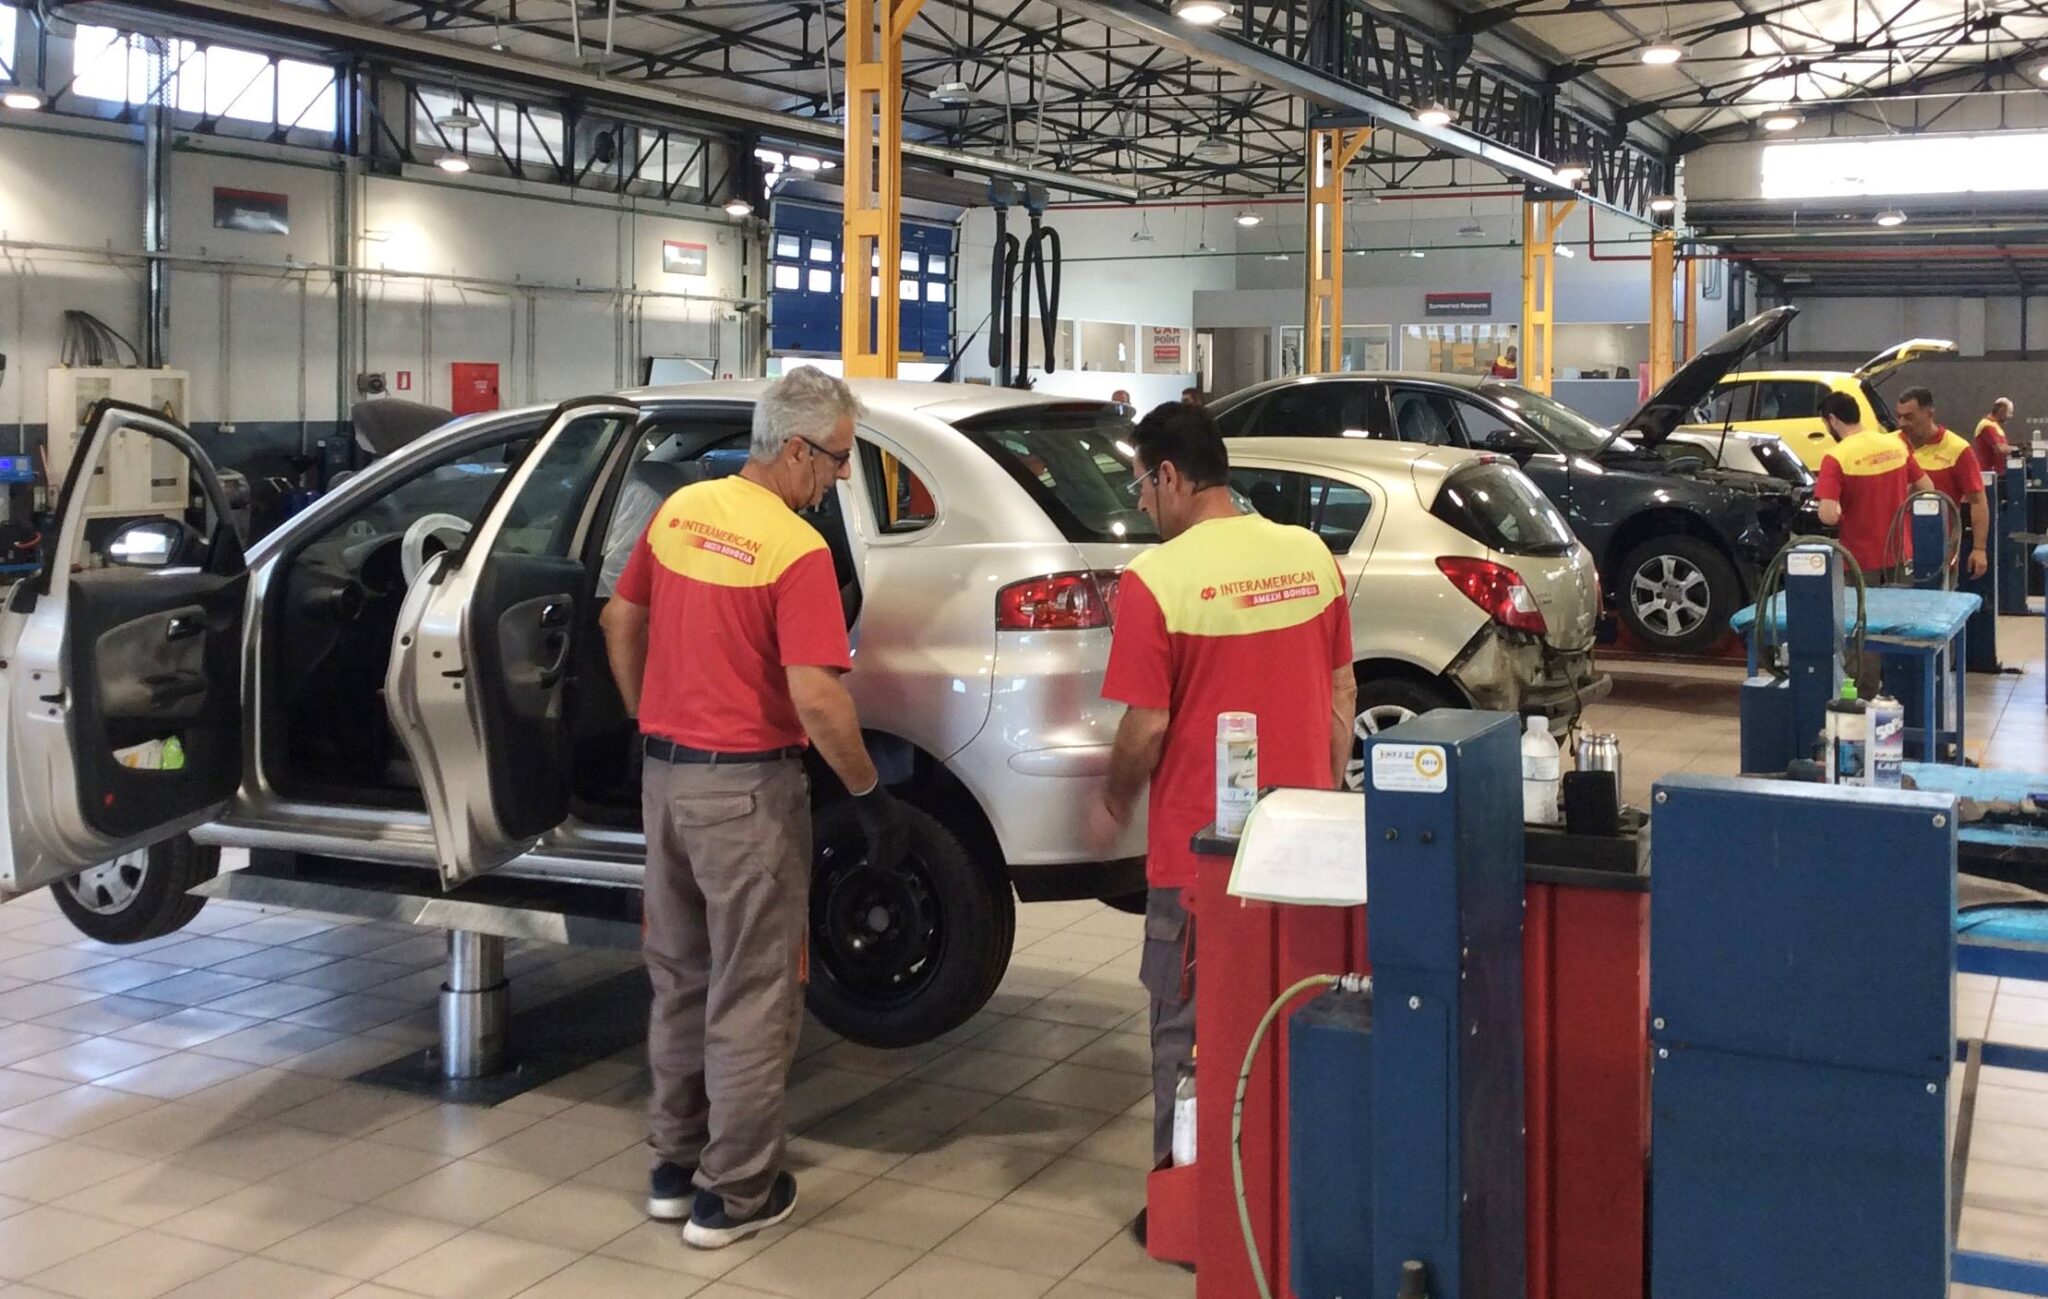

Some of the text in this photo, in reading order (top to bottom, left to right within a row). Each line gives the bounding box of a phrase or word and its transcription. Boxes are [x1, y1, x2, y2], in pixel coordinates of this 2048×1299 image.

[1153, 334, 1181, 344] POINT
[681, 519, 762, 554] INTERAMERICAN
[1220, 570, 1316, 596] INTERAMERICAN
[1252, 591, 1282, 605] ΑΜΕΣΗ
